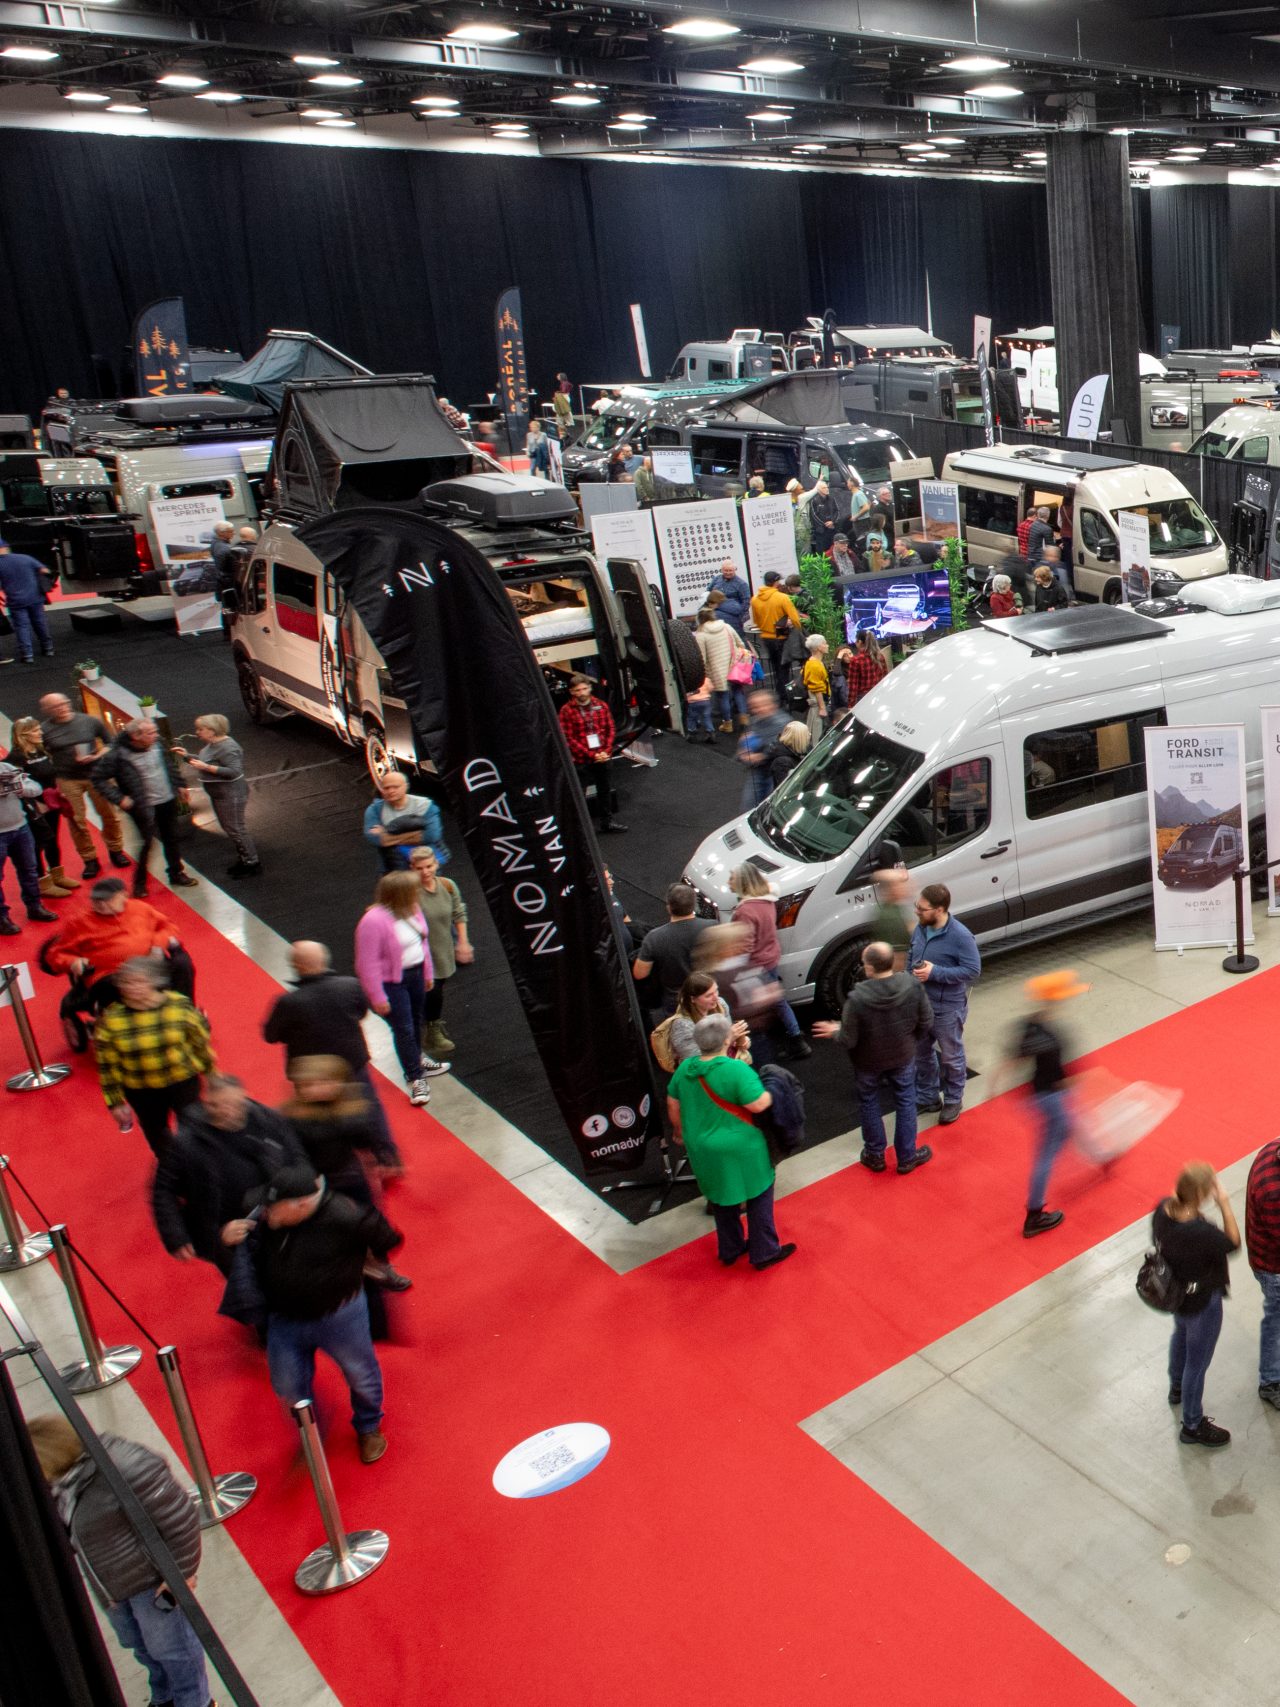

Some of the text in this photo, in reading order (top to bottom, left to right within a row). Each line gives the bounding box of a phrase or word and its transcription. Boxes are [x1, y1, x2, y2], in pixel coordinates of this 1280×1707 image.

[1077, 393, 1095, 428] UIP
[922, 485, 957, 497] VANLIFE
[157, 501, 206, 513] MERCEDES
[174, 507, 218, 517] SPRINTER
[751, 509, 787, 523] LA LIBERTÉ
[751, 514, 788, 529] ÇA SE CRÉE
[398, 561, 435, 592] N
[1167, 738, 1200, 749] FORD
[1167, 747, 1225, 759] TRANSIT
[535, 815, 569, 873] VAN
[464, 757, 565, 956] NOMAD
[1184, 899, 1222, 908] NOMAD
[590, 1134, 646, 1159] nomadv
